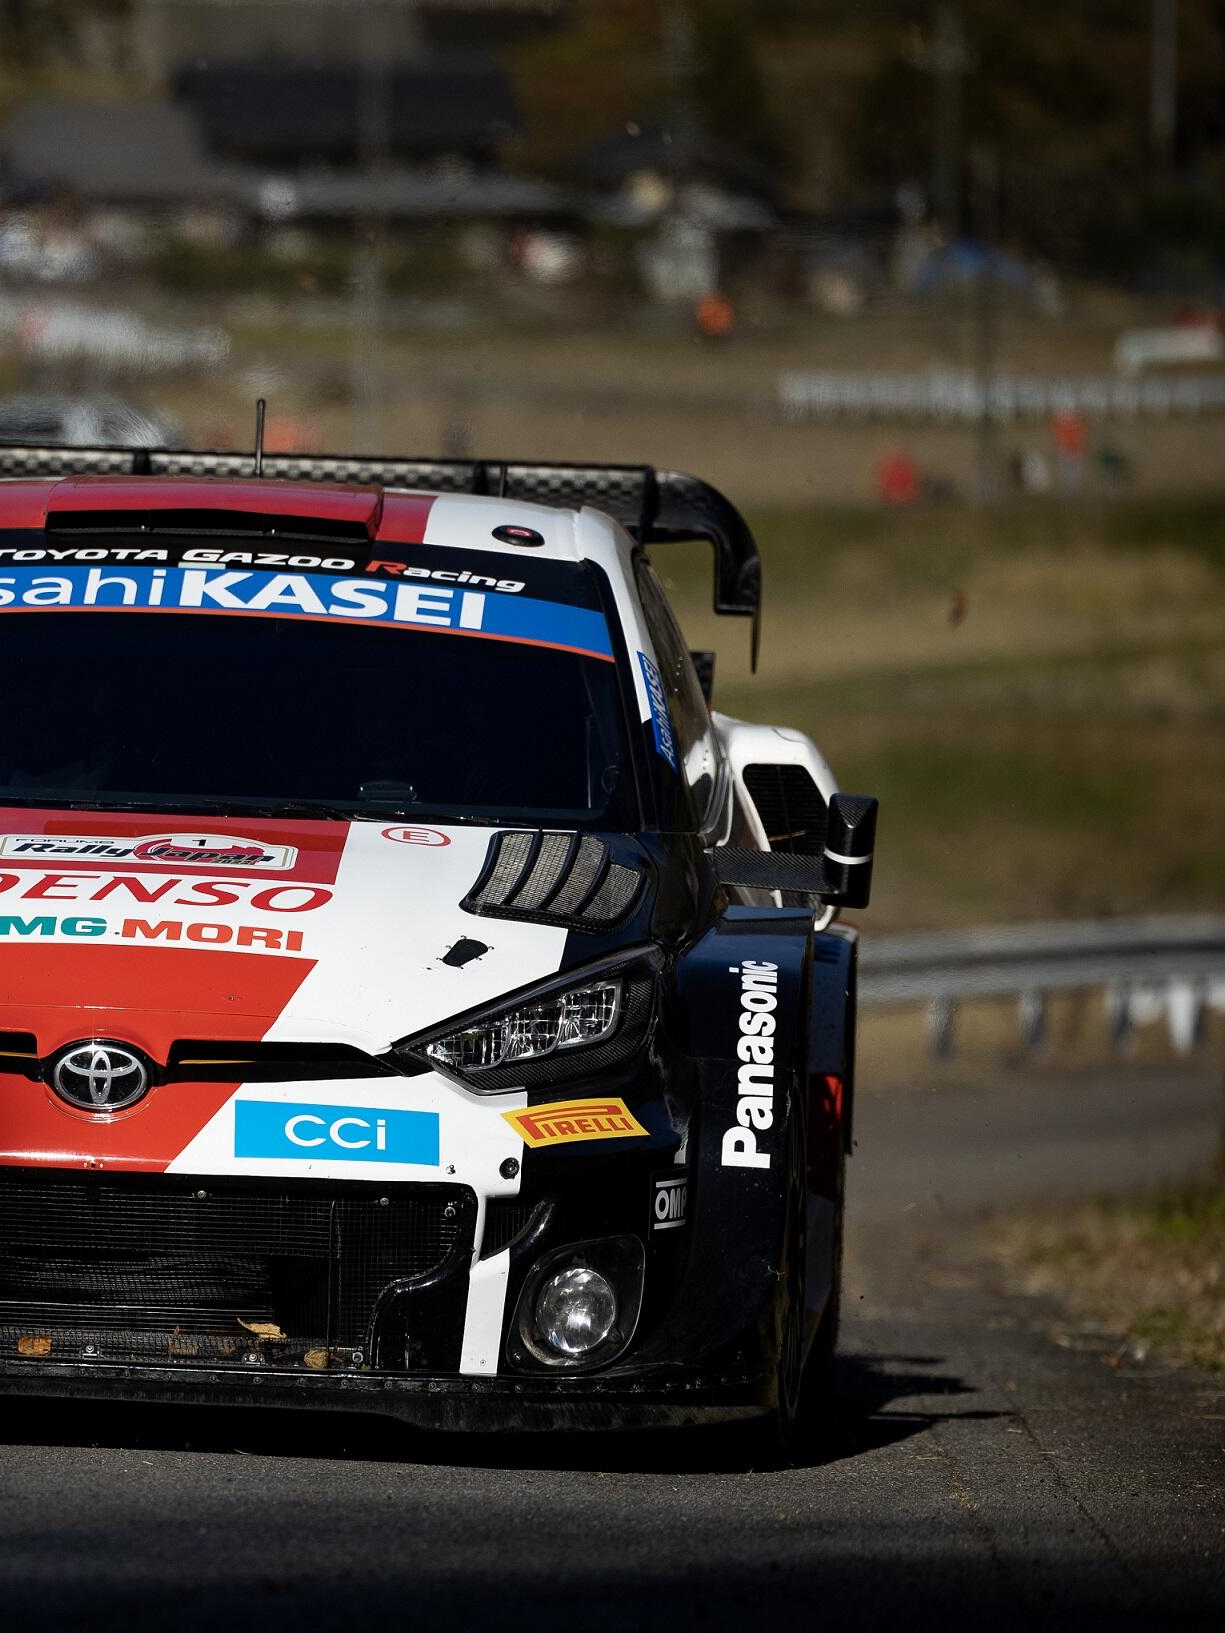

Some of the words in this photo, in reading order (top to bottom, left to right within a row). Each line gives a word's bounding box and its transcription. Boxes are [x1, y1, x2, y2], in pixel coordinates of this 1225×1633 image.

[181, 548, 356, 571] GAZOO
[364, 559, 526, 593] Racing
[13, 843, 134, 858] Rally
[138, 846, 275, 863] Japan
[191, 838, 208, 847] 1
[120, 918, 304, 952] MORI
[721, 960, 779, 1169] Panasonic
[515, 1105, 635, 1140] PIRELLI
